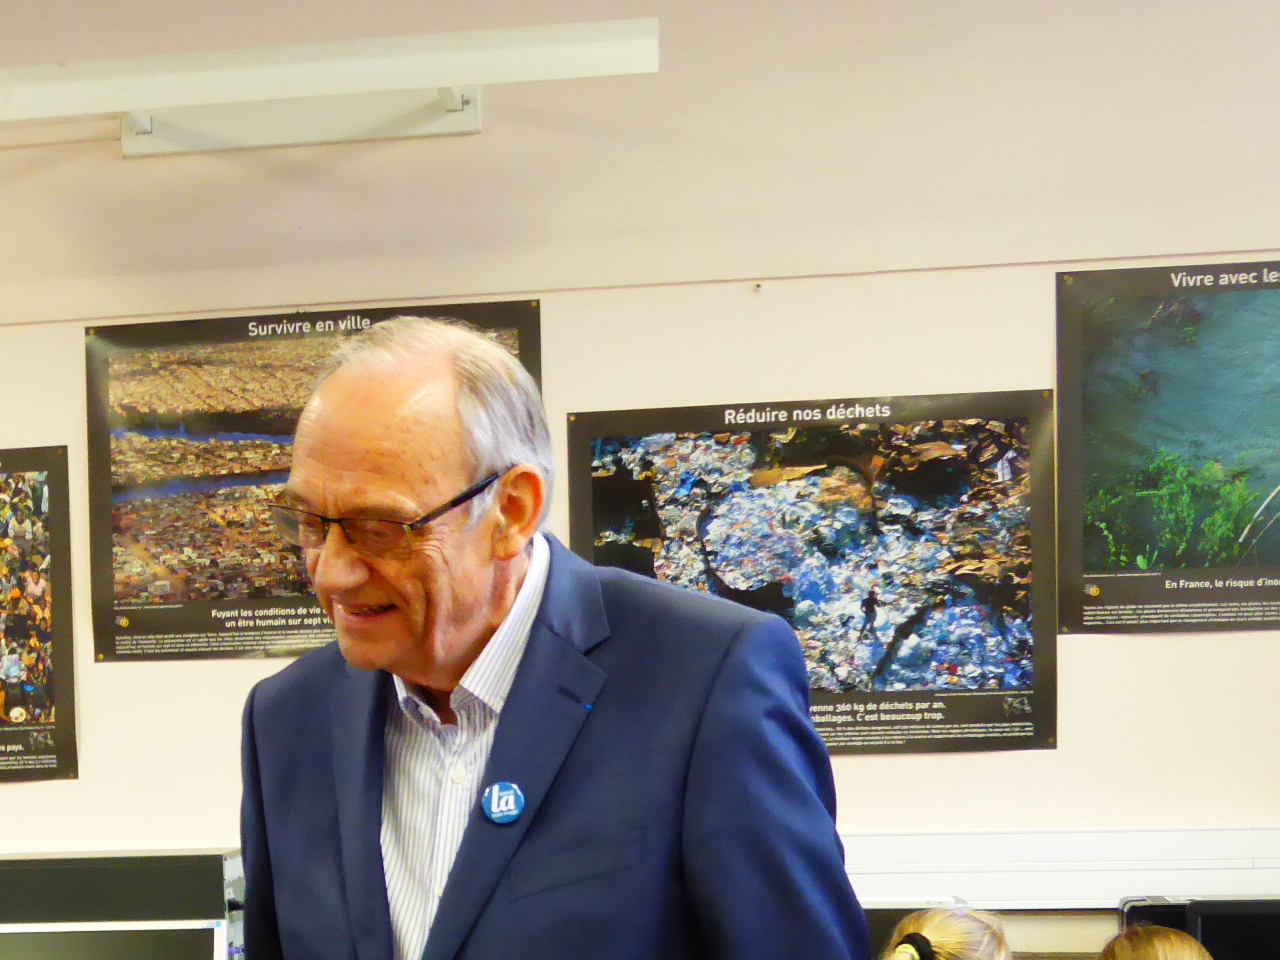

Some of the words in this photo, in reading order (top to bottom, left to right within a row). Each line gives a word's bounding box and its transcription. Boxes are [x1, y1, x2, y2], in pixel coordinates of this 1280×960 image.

[1171, 272, 1214, 287] Vivre
[1219, 272, 1258, 286] avec
[248, 320, 311, 336] Survivre
[315, 320, 334, 332] en
[338, 315, 371, 330] ville
[724, 407, 789, 424] Réduire
[792, 408, 822, 421] nos
[826, 403, 892, 420] déchets
[1165, 580, 1178, 589] En
[1179, 580, 1213, 589] France,
[1215, 579, 1223, 588] le
[1225, 578, 1255, 589] risque
[211, 609, 239, 620] Fuyant
[240, 608, 253, 617] les
[254, 606, 296, 617] conditions
[297, 606, 308, 615] de
[309, 605, 321, 615] vie
[225, 620, 236, 628] un
[237, 618, 255, 628] être
[256, 617, 287, 627] humain
[288, 618, 301, 626] sur
[303, 617, 322, 627] sept
[835, 703, 852, 713] 360
[853, 703, 865, 713] kg
[866, 702, 877, 711] de
[879, 701, 915, 711] déchets
[915, 702, 930, 711] par
[932, 701, 947, 710] an.
[856, 712, 879, 722] C'est
[880, 712, 922, 722] beaucoup
[924, 711, 946, 721] trop.
[6, 743, 25, 754] pays.
